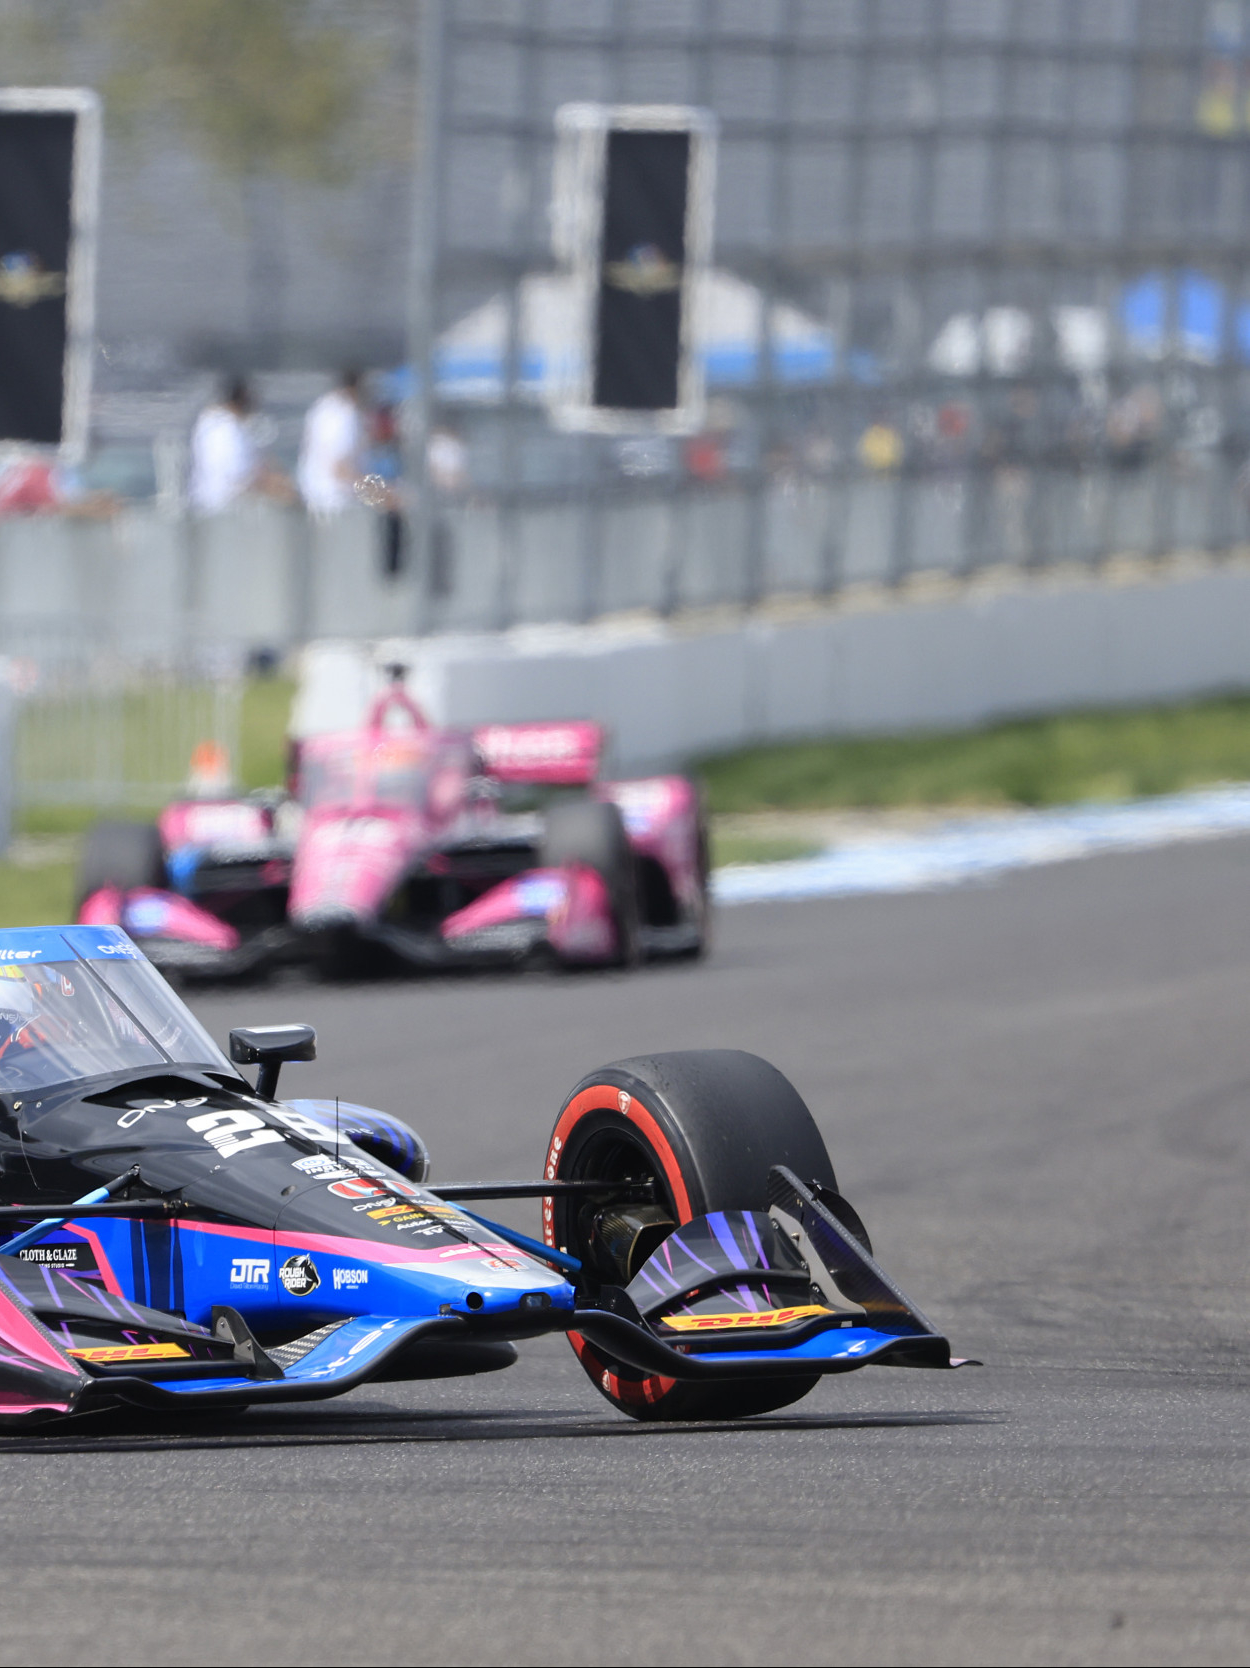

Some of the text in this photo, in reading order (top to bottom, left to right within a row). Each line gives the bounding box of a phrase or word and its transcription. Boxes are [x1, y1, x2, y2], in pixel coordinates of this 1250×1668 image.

[46, 1249, 53, 1261] &
[53, 1249, 78, 1261] GLAZE
[279, 1267, 306, 1279] ROUGH
[333, 1268, 368, 1289] HOBSON
[284, 1278, 307, 1289] RIDER
[691, 1310, 808, 1328] DHL
